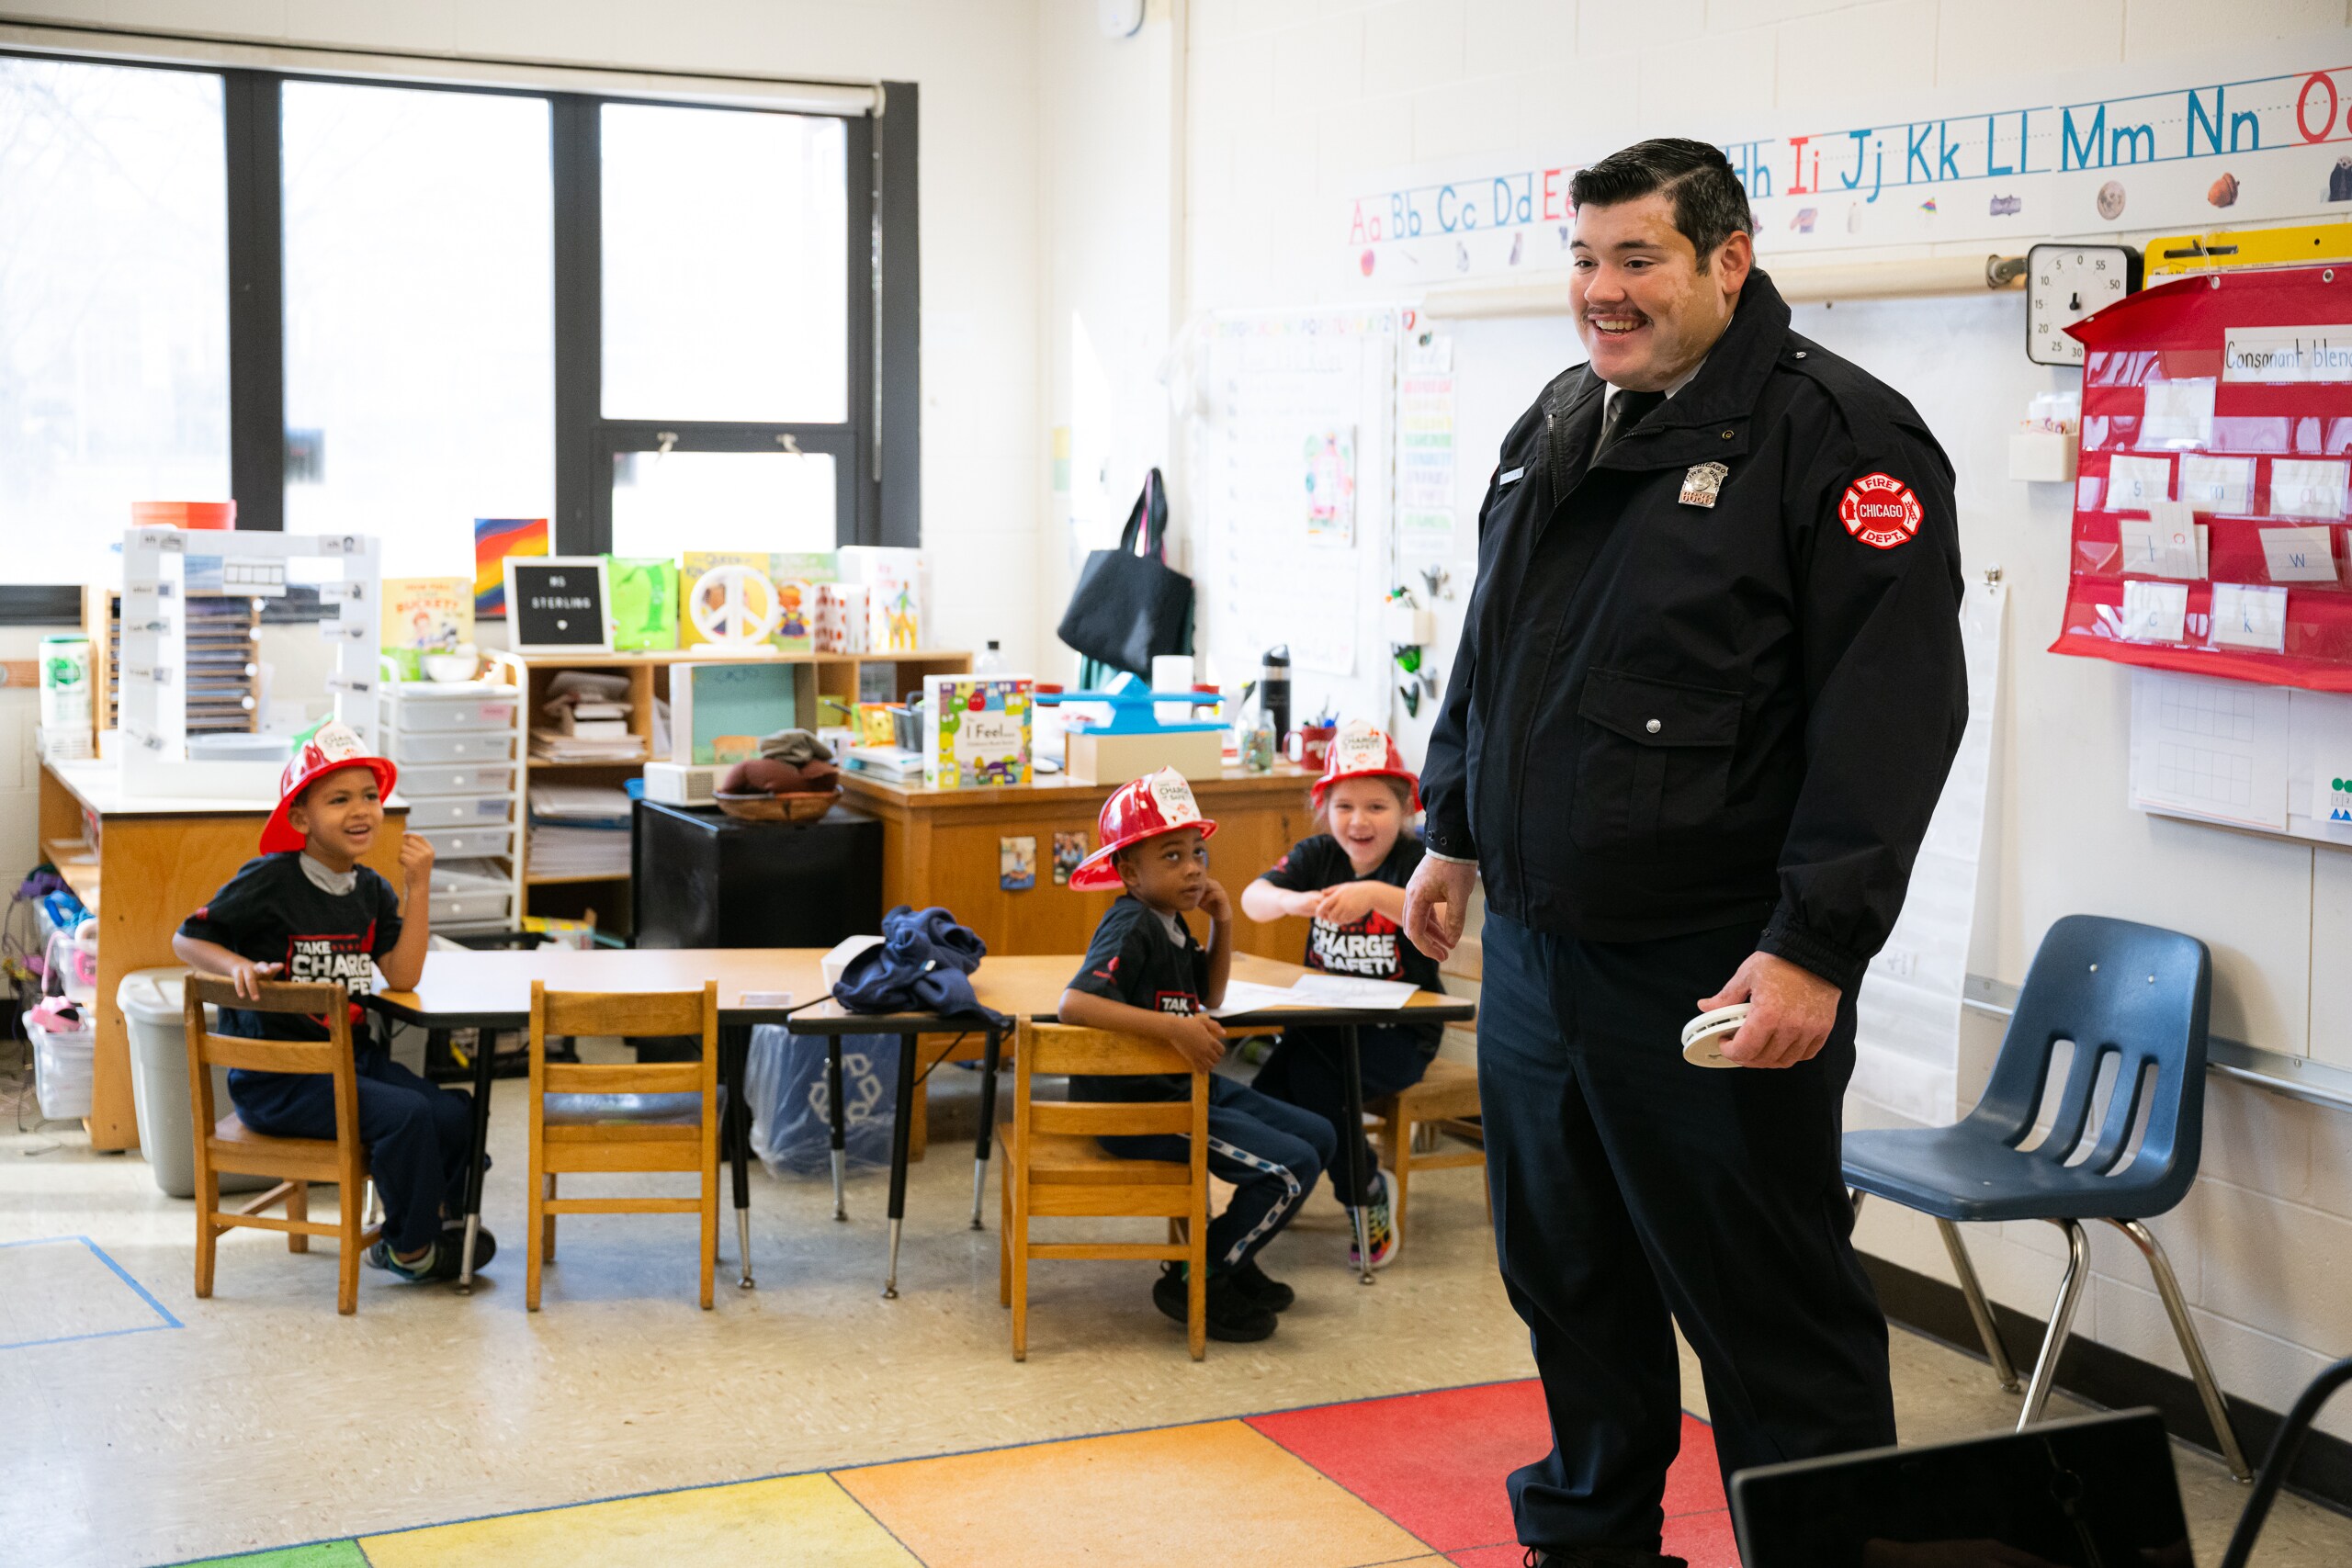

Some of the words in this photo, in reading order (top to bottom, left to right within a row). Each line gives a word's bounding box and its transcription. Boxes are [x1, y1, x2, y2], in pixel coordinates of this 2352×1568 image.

[1349, 199, 1381, 245] Aa
[1391, 192, 1421, 239] Bb
[1438, 186, 1476, 232] Cc
[1494, 173, 1532, 226] Dd
[1788, 137, 1819, 195] Ii
[1841, 129, 1883, 203] Jj
[1907, 120, 1960, 184] Kk
[1988, 110, 2027, 176] Ll
[2063, 102, 2154, 172] Mm
[2187, 85, 2259, 157] Nn
[2056, 260, 2062, 270] 5
[2077, 254, 2084, 265] 0
[2096, 260, 2106, 270] 55
[2041, 276, 2050, 286] 10
[2109, 279, 2120, 289] 50
[2035, 299, 2043, 309] 15
[2038, 323, 2049, 333] 20
[2052, 342, 2063, 352] 25
[2072, 347, 2083, 357] 30
[2225, 338, 2303, 368] Consonant
[1690, 463, 1726, 474] CHICAGO
[1685, 468, 1703, 482] FIRE
[1865, 478, 1894, 490] FIRE
[1682, 491, 1713, 504] 6686
[1859, 503, 1904, 517] CHICAGO
[1866, 532, 1903, 543] DEPT.
[531, 596, 592, 610] STERLING
[293, 941, 332, 954] TAKE
[291, 953, 371, 976] CHARG
[1322, 953, 1397, 976] SAFETY
